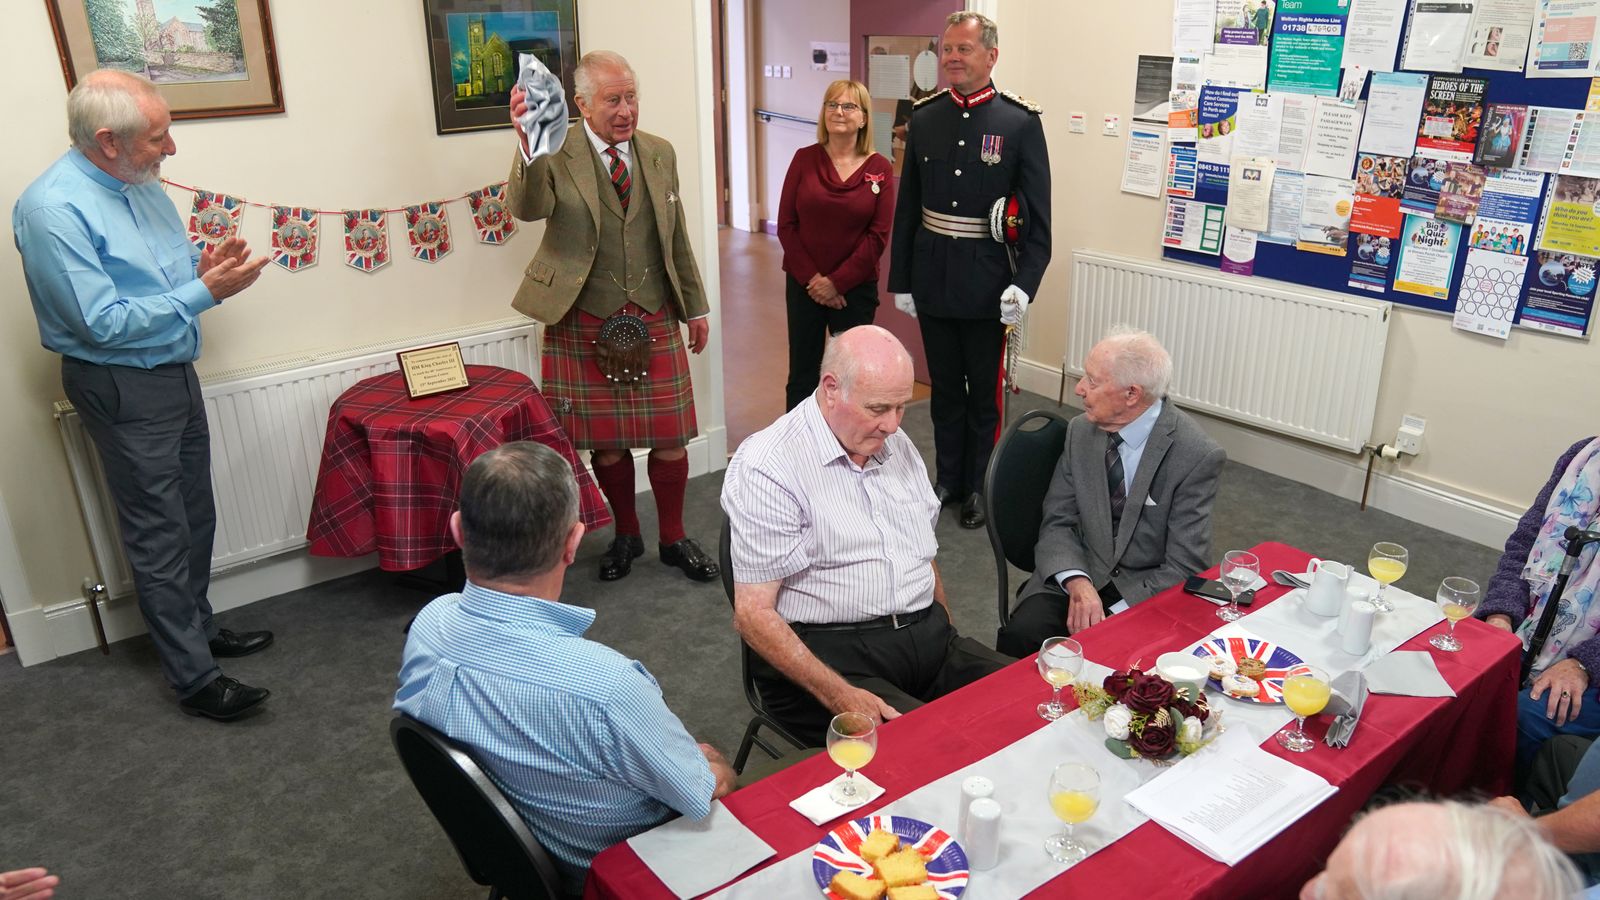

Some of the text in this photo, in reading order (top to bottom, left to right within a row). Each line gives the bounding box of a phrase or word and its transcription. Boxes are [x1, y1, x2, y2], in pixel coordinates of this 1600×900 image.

[1282, 0, 1302, 8] Team
[1432, 80, 1484, 93] HEROES OF THE
[1430, 90, 1456, 101] SCREEN
[1426, 222, 1439, 231] Big
[1427, 229, 1445, 238] Quiz
[1418, 235, 1444, 246] Night
